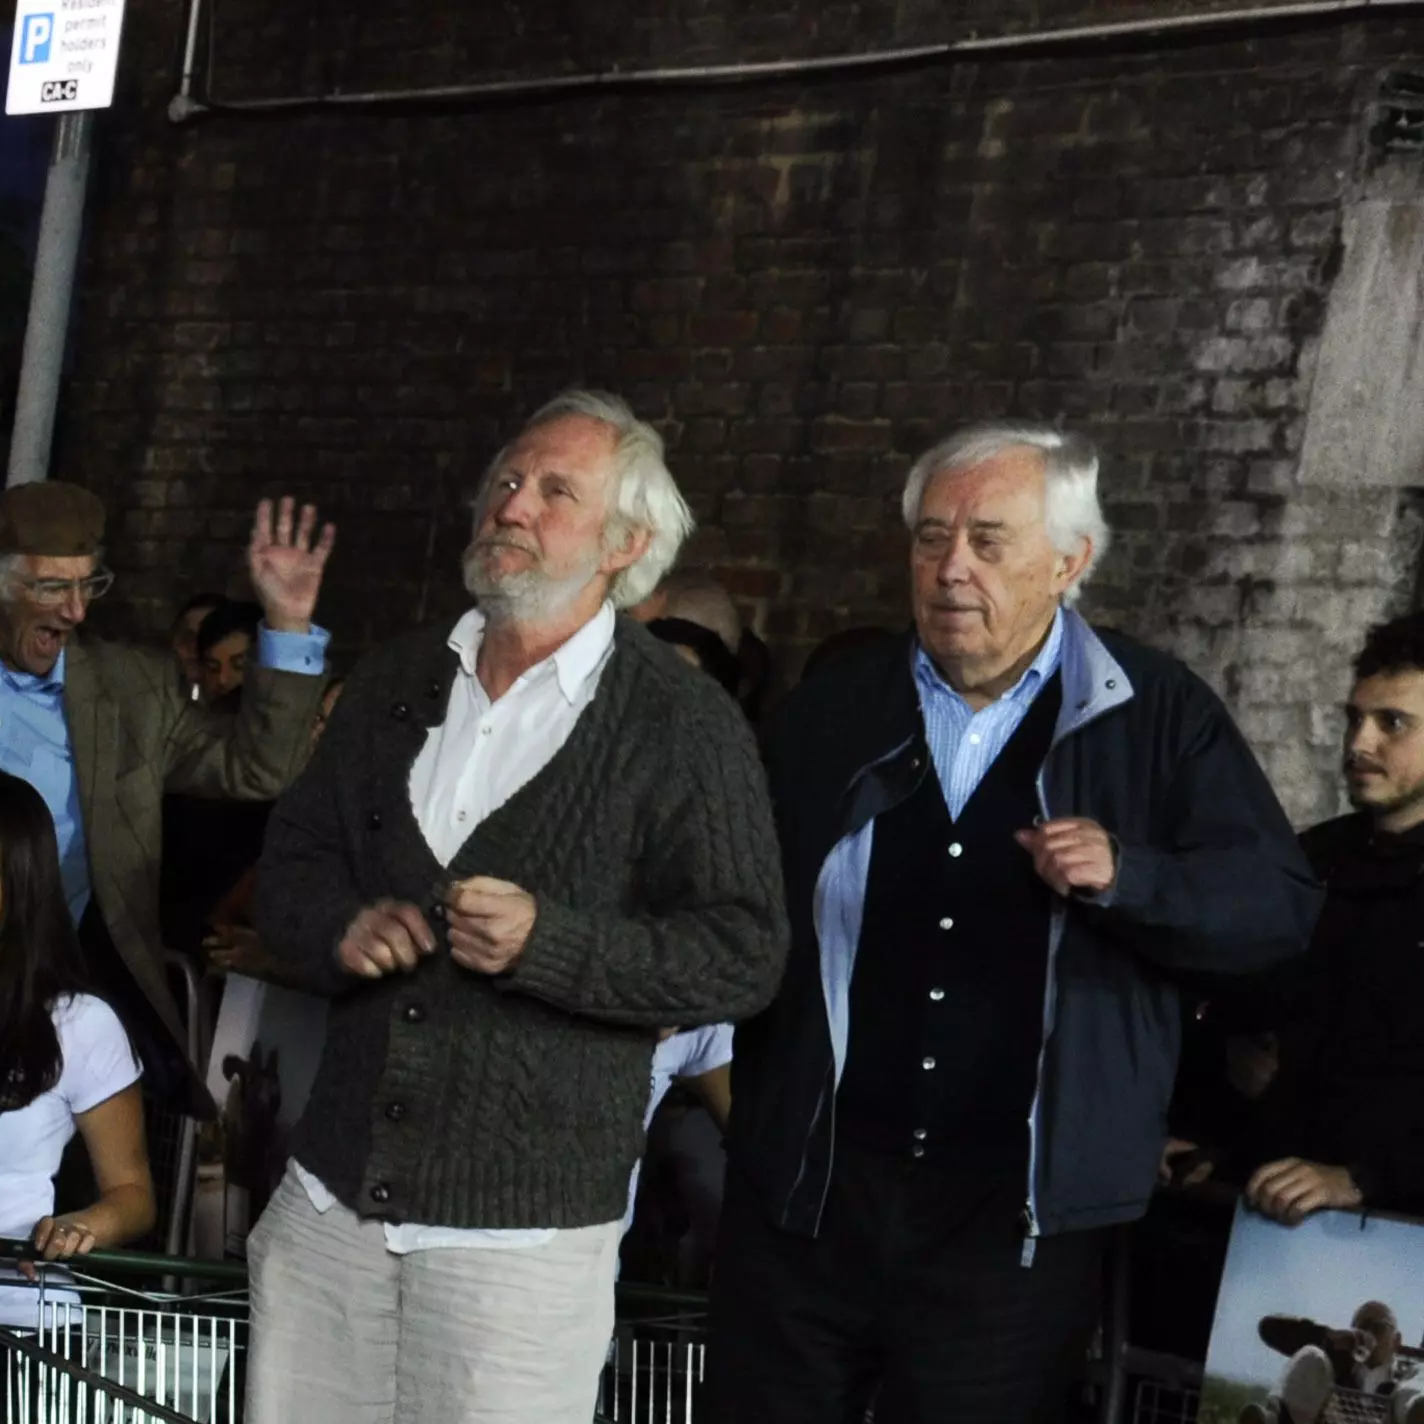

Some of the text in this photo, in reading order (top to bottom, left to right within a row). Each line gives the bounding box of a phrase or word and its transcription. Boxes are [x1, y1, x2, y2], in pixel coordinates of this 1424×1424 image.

[64, 15, 107, 32] permit
[25, 17, 50, 61] P
[60, 37, 106, 52] holders
[66, 58, 93, 74] only
